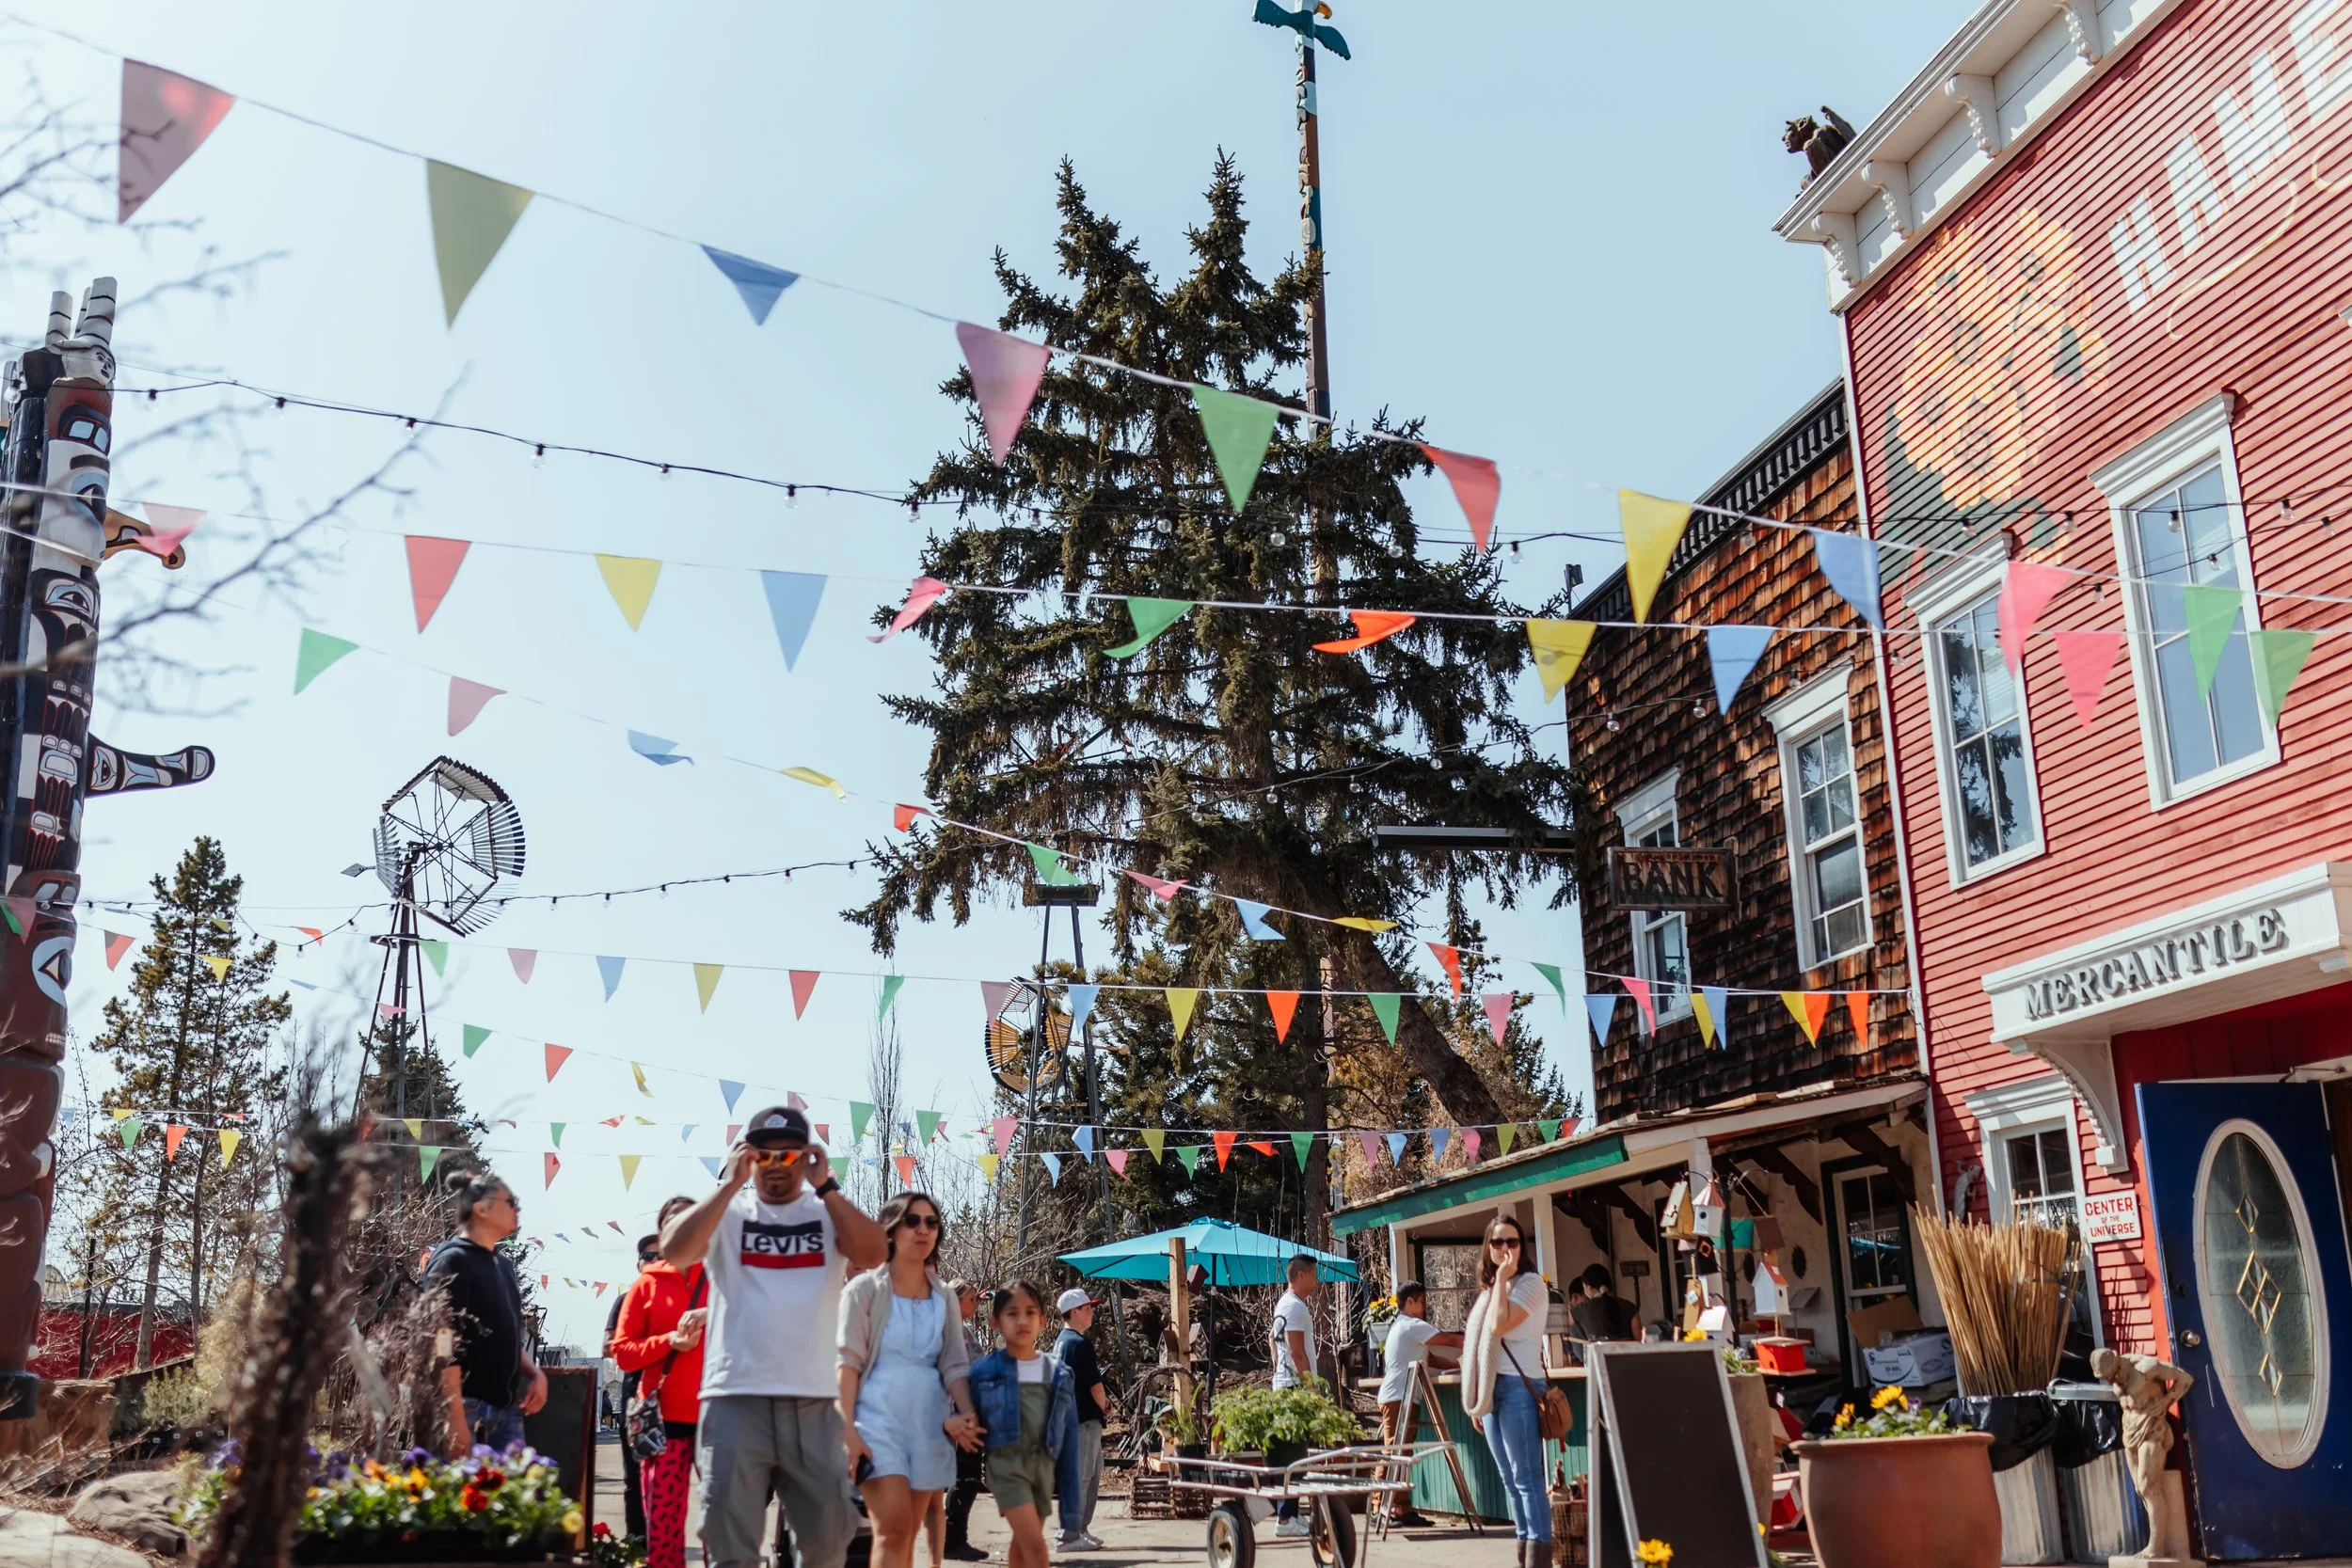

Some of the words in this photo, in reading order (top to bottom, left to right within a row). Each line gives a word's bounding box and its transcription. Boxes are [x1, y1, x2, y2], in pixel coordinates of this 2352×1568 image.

[1623, 862, 1724, 898] BANK
[2025, 908, 2290, 1022] MERCANTILE
[2085, 1196, 2134, 1215] CENTER
[2090, 1223, 2135, 1237] UNIVERSE
